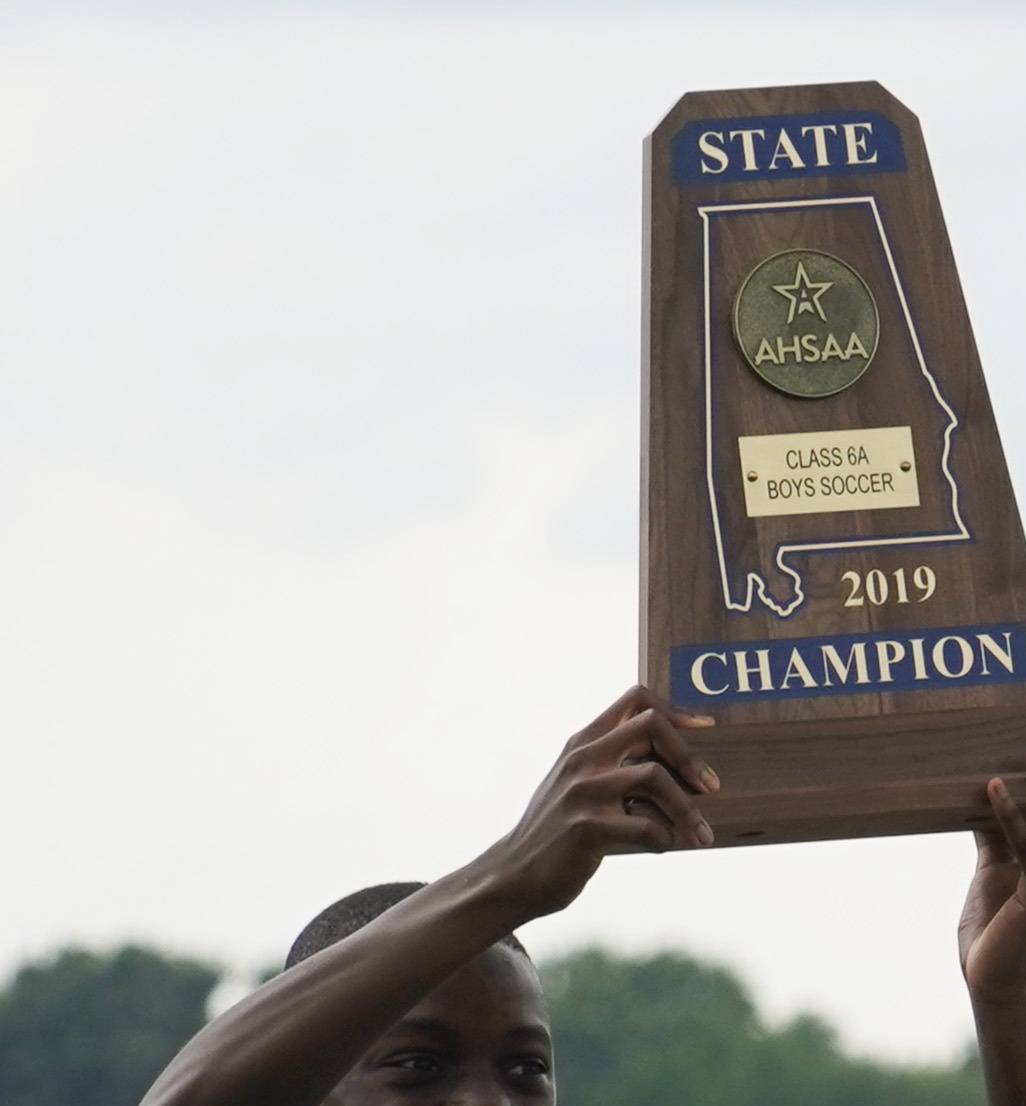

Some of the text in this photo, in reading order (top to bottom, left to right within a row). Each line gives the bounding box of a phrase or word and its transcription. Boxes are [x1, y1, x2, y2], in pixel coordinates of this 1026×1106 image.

[699, 122, 878, 174] STATE
[754, 331, 869, 366] AHSAA
[786, 445, 870, 470] CLASS 6A
[767, 472, 895, 500] BOYS SOCCER
[841, 565, 937, 607] 2019
[690, 632, 1015, 696] CHAMPION
